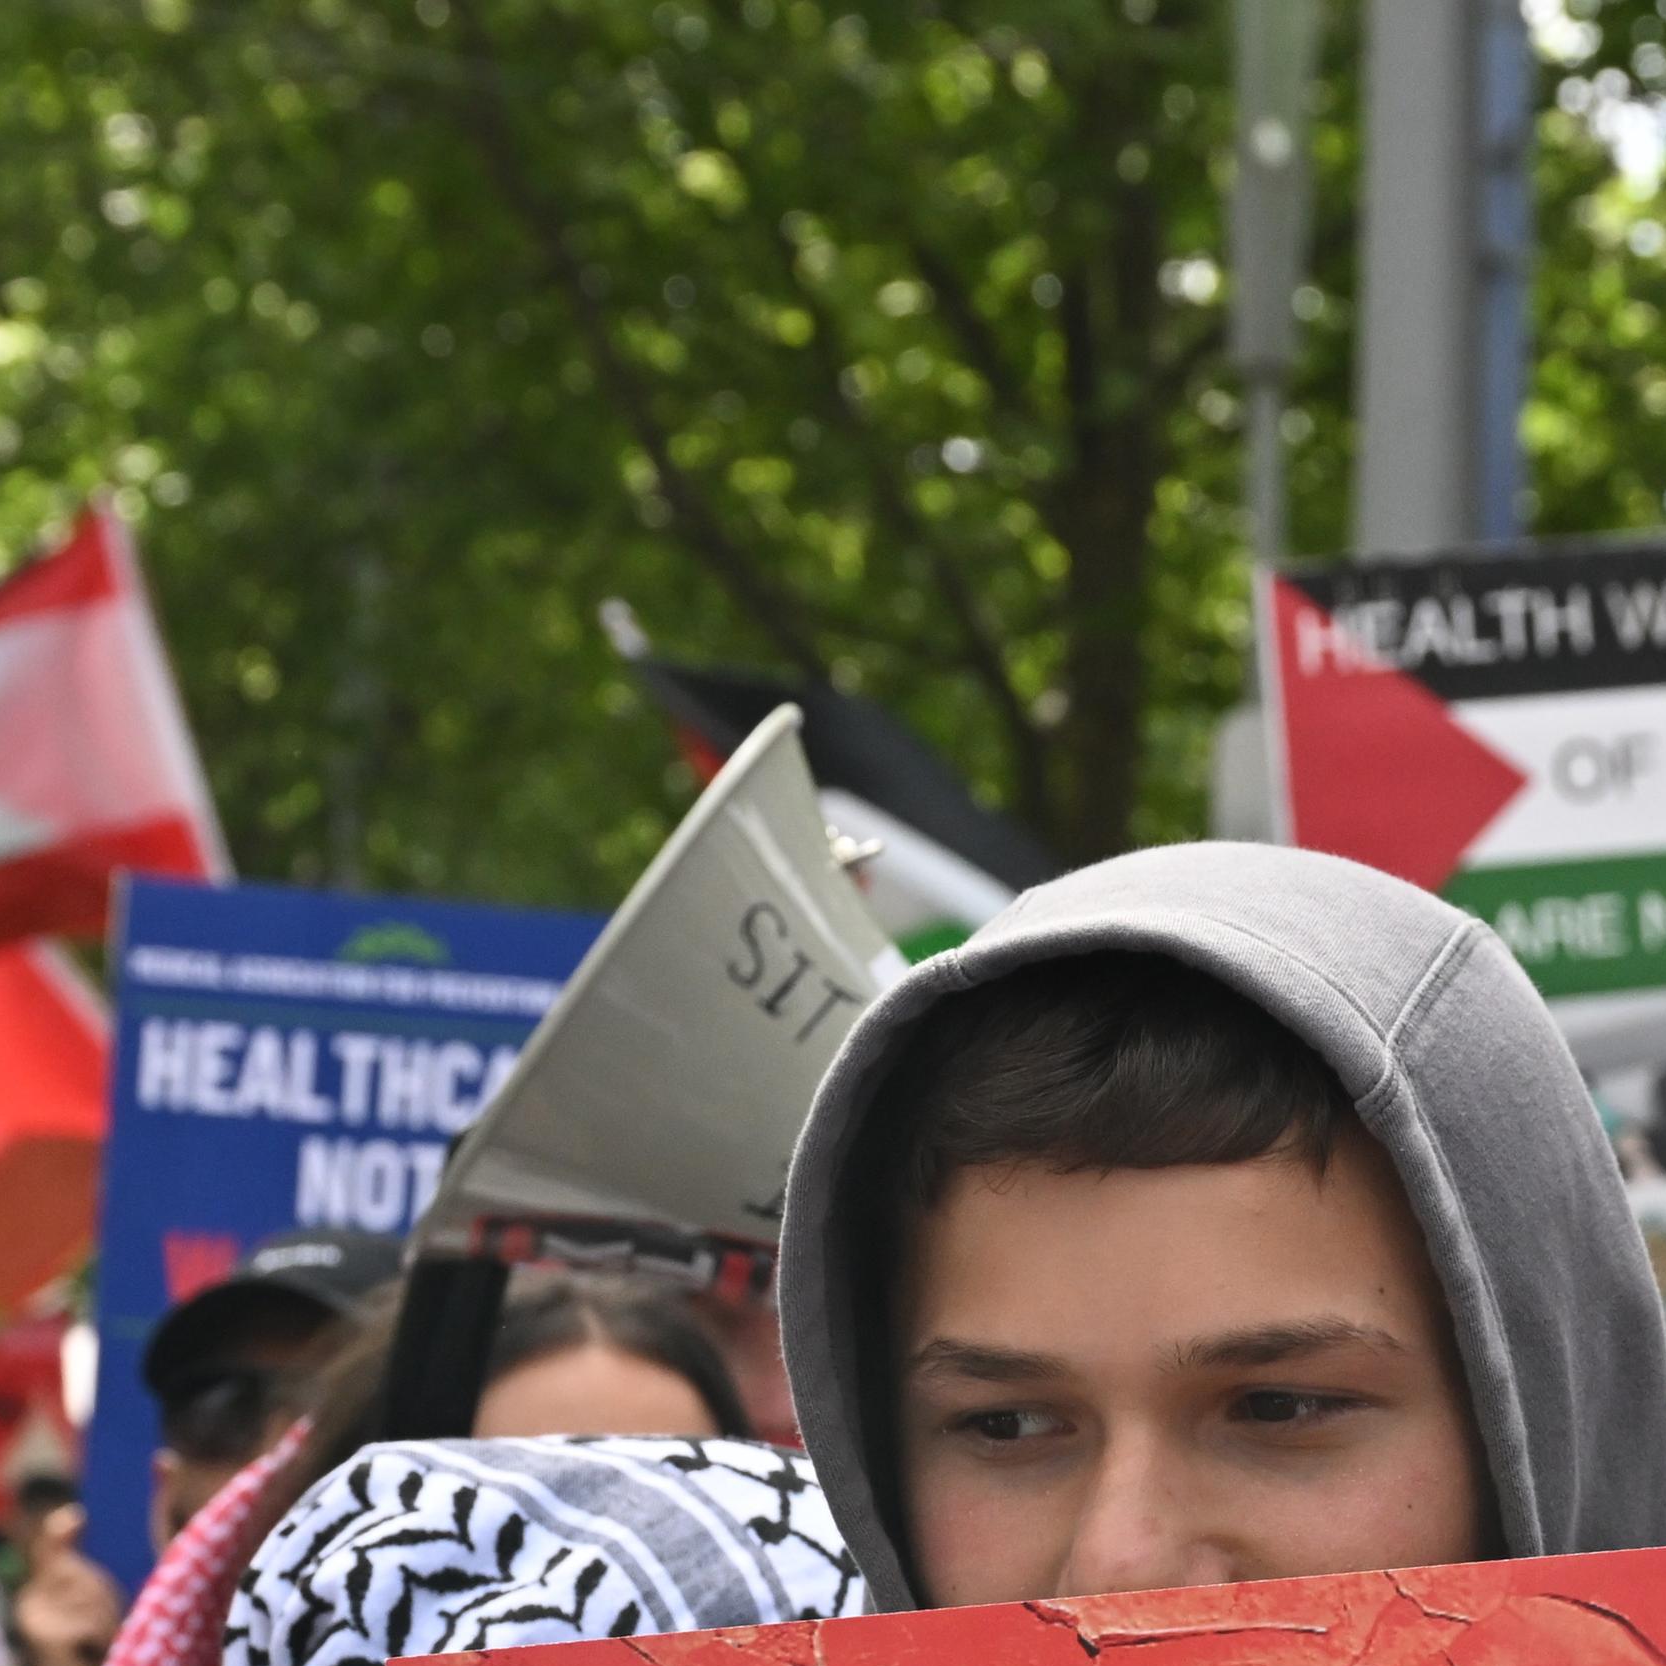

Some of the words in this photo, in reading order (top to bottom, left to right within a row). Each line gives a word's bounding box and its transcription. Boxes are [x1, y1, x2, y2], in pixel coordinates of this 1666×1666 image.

[1296, 577, 1595, 676] HEALTH
[1549, 730, 1655, 803] OF
[1494, 892, 1631, 963] ARE
